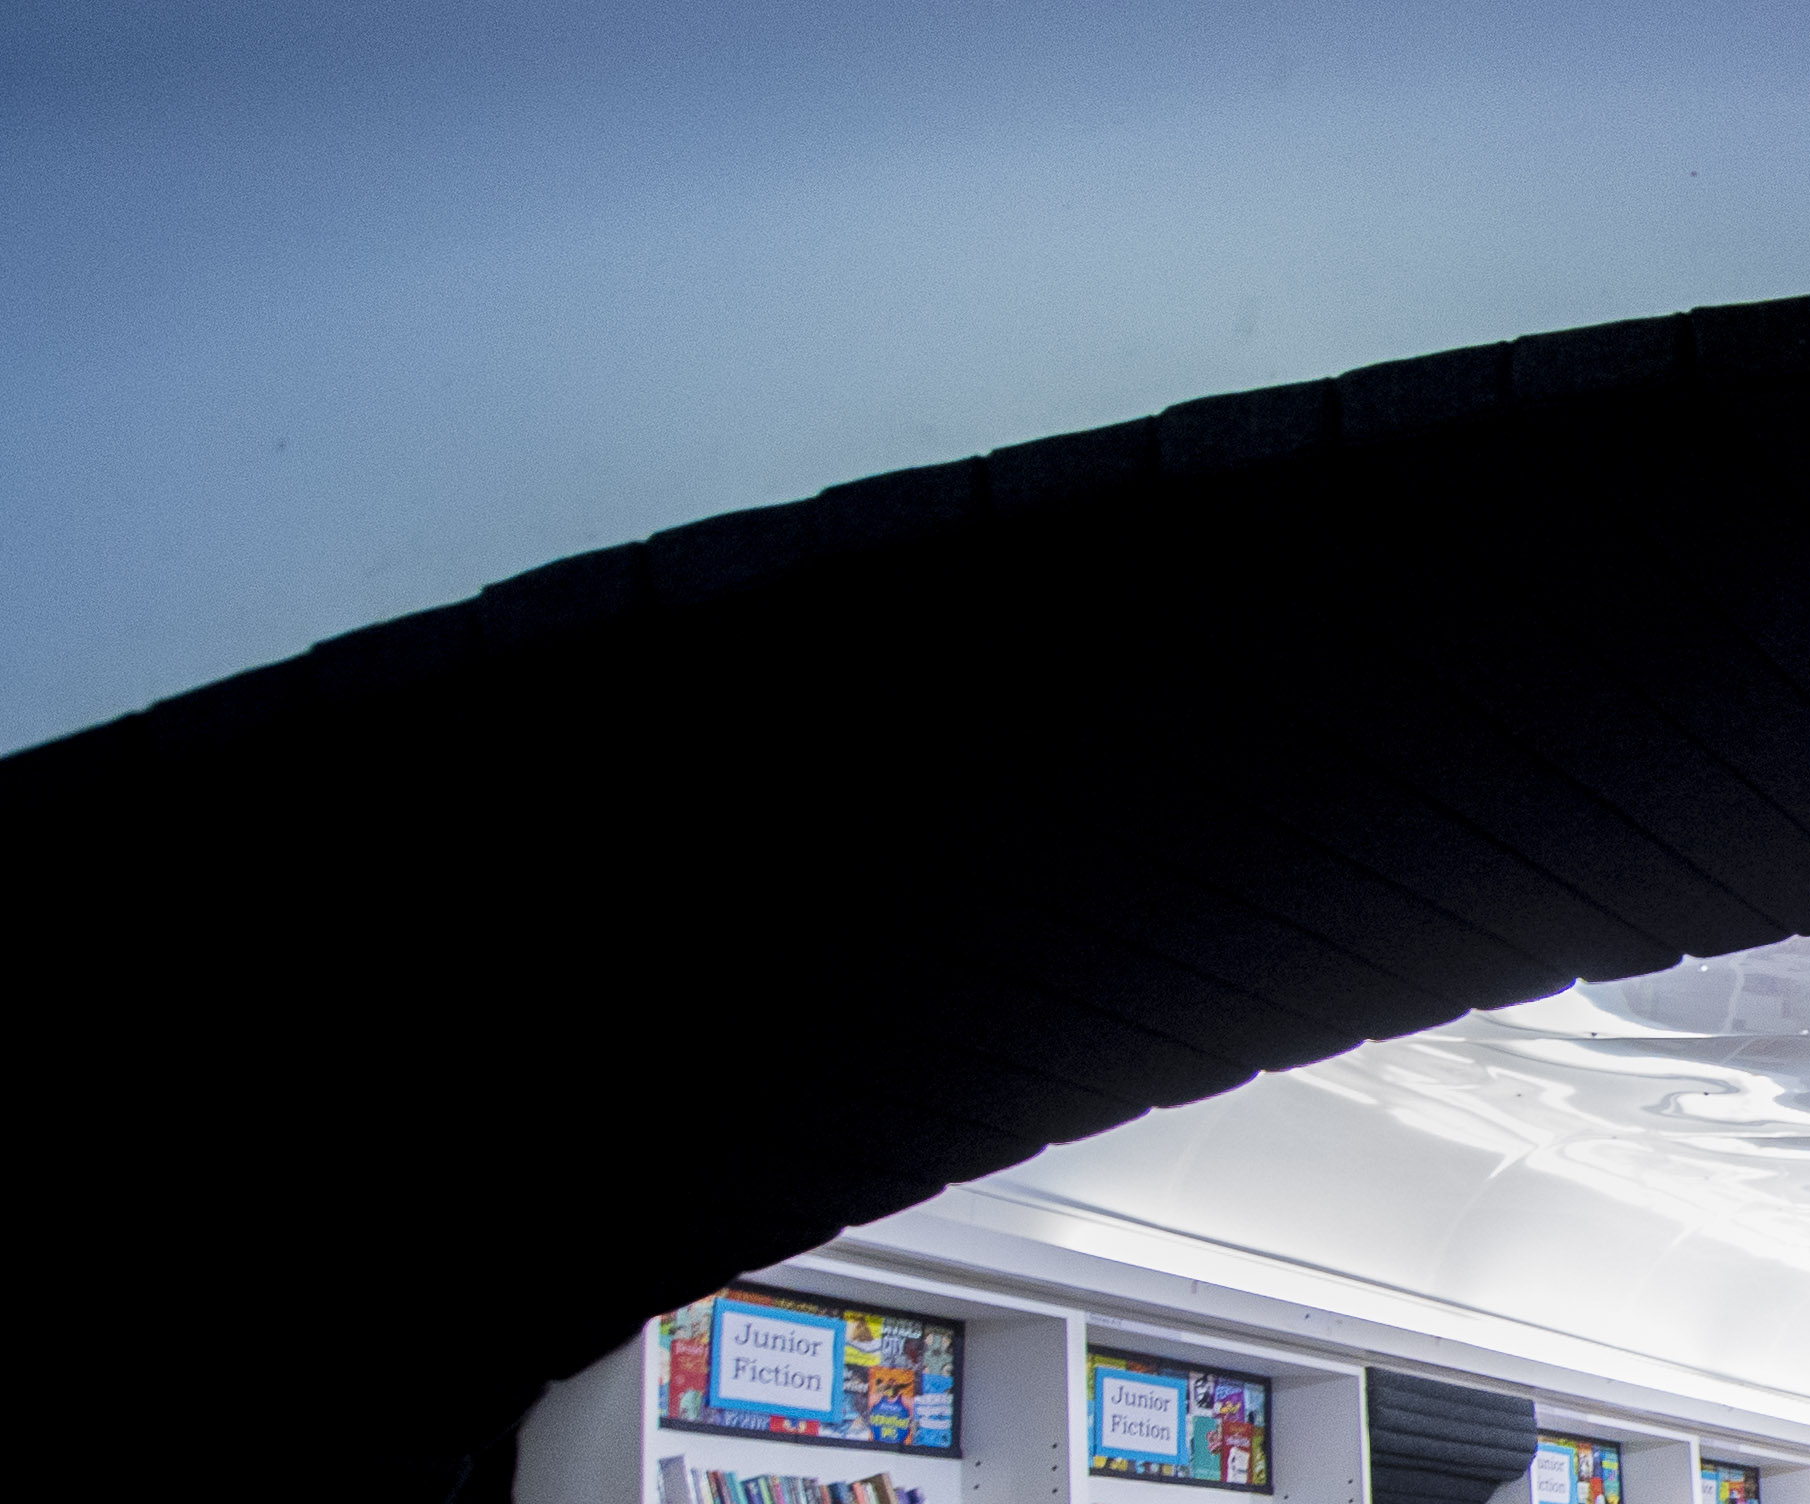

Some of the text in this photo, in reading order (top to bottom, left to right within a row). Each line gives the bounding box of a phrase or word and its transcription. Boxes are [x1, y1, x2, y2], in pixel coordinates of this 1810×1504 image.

[734, 1322, 823, 1357] Junior
[732, 1356, 823, 1392] Fiction
[1110, 1386, 1172, 1413] Junior
[1110, 1413, 1171, 1441] Fiction
[1537, 1455, 1566, 1472] unior
